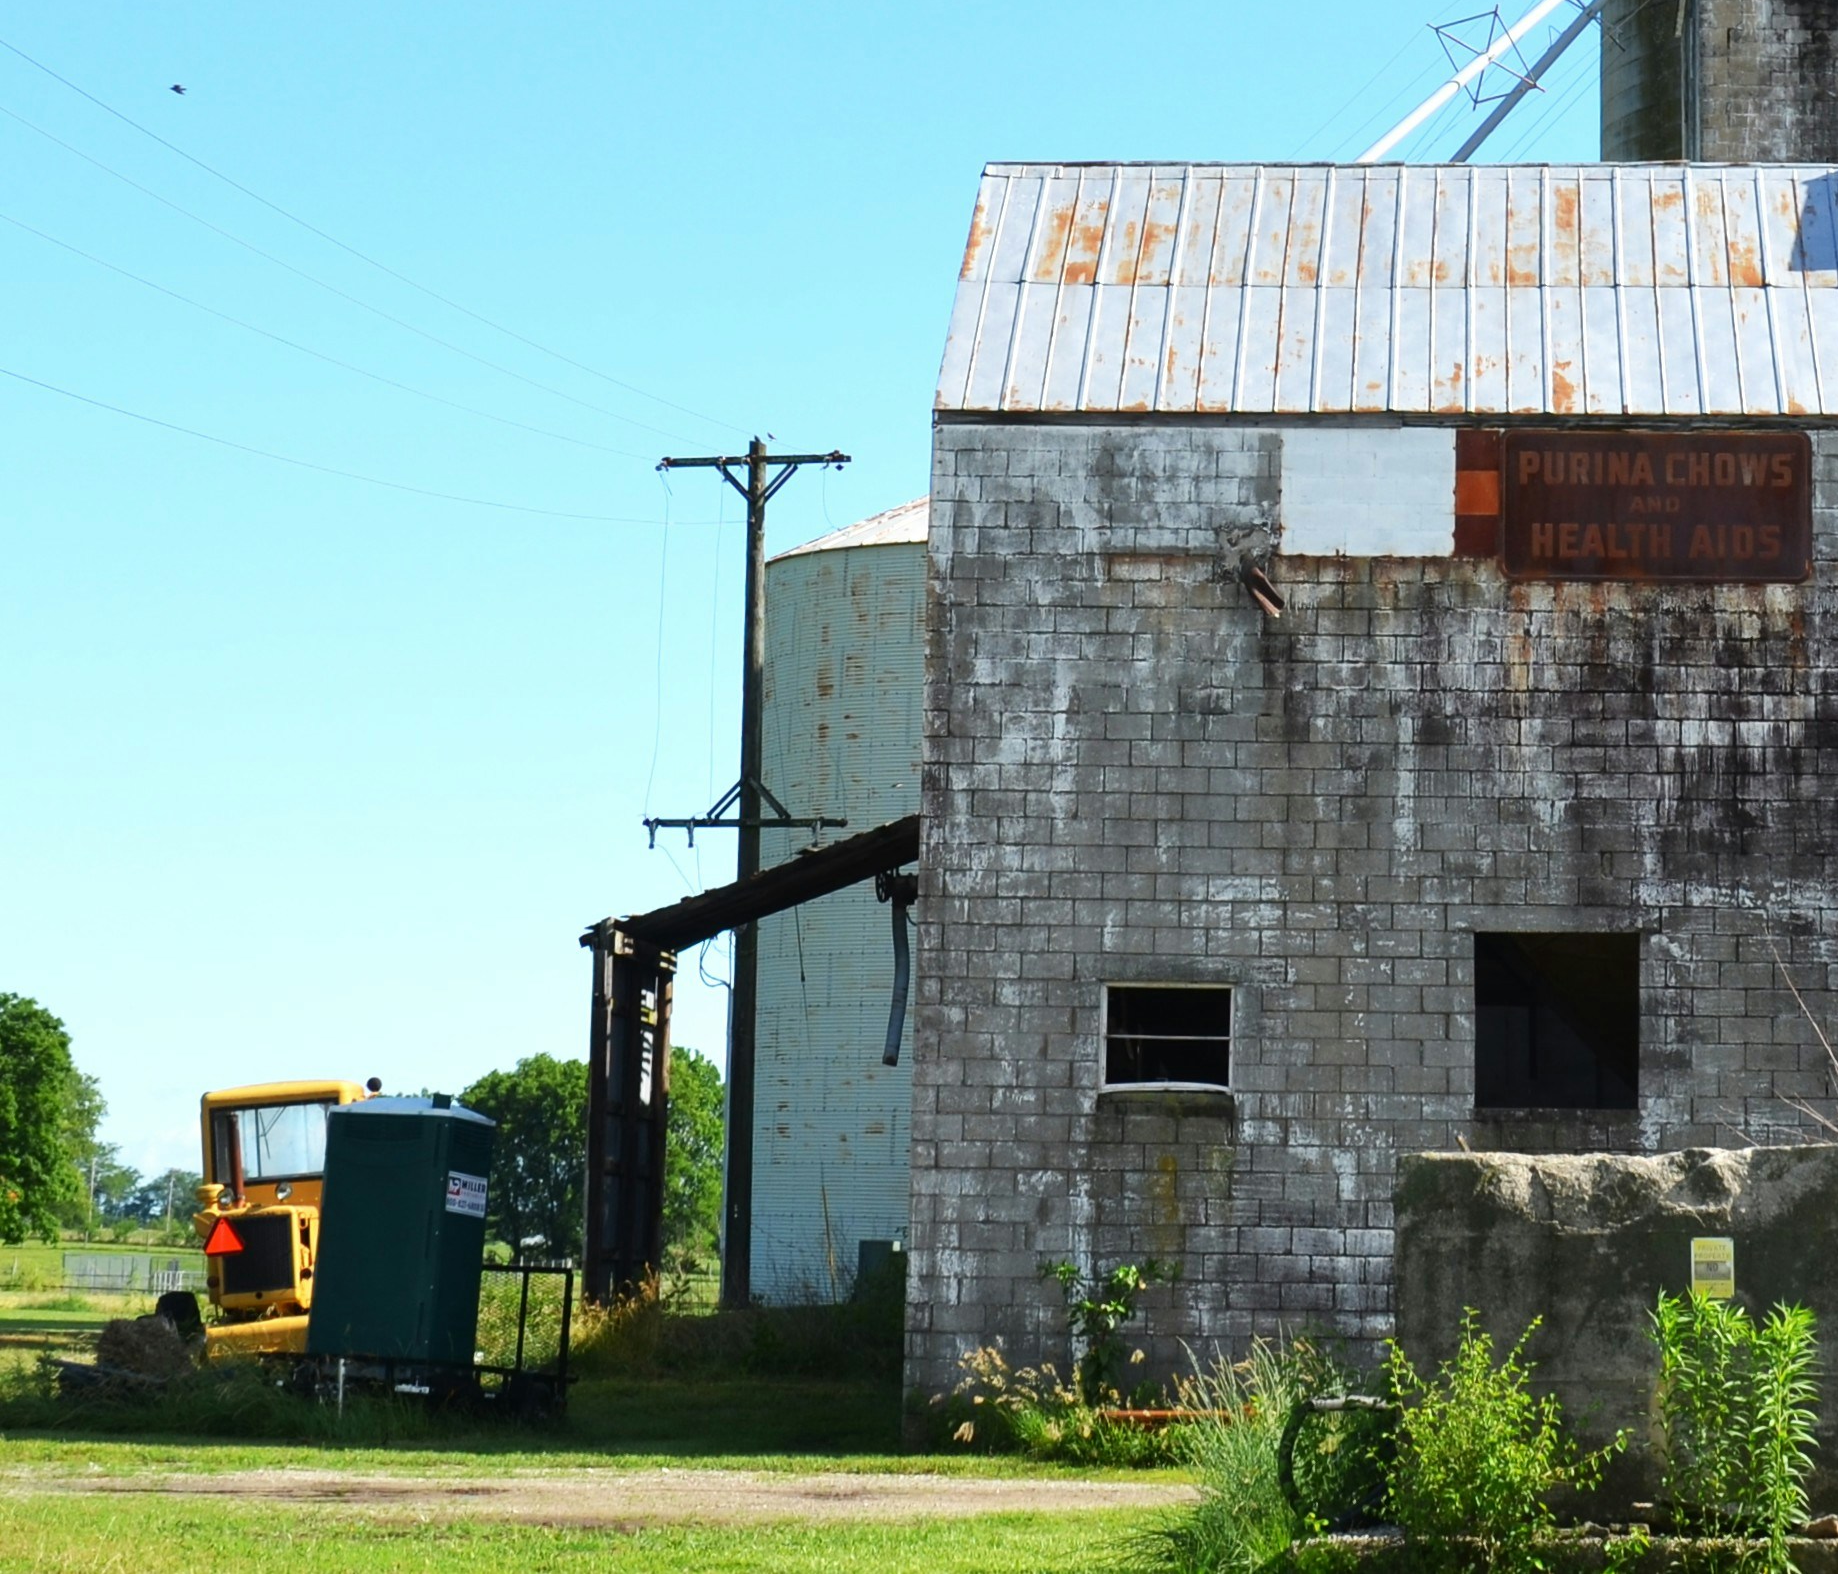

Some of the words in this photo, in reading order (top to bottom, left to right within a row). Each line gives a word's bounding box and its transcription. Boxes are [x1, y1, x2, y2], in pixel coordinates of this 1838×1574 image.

[1519, 450, 1655, 486] PURINA
[1665, 452, 1794, 488] CHOWS
[1630, 496, 1681, 514] AND
[1532, 523, 1672, 559] HEALTH
[1688, 525, 1781, 560] AIDS
[461, 1180, 486, 1193] MILLER
[1706, 1262, 1719, 1272] NO
